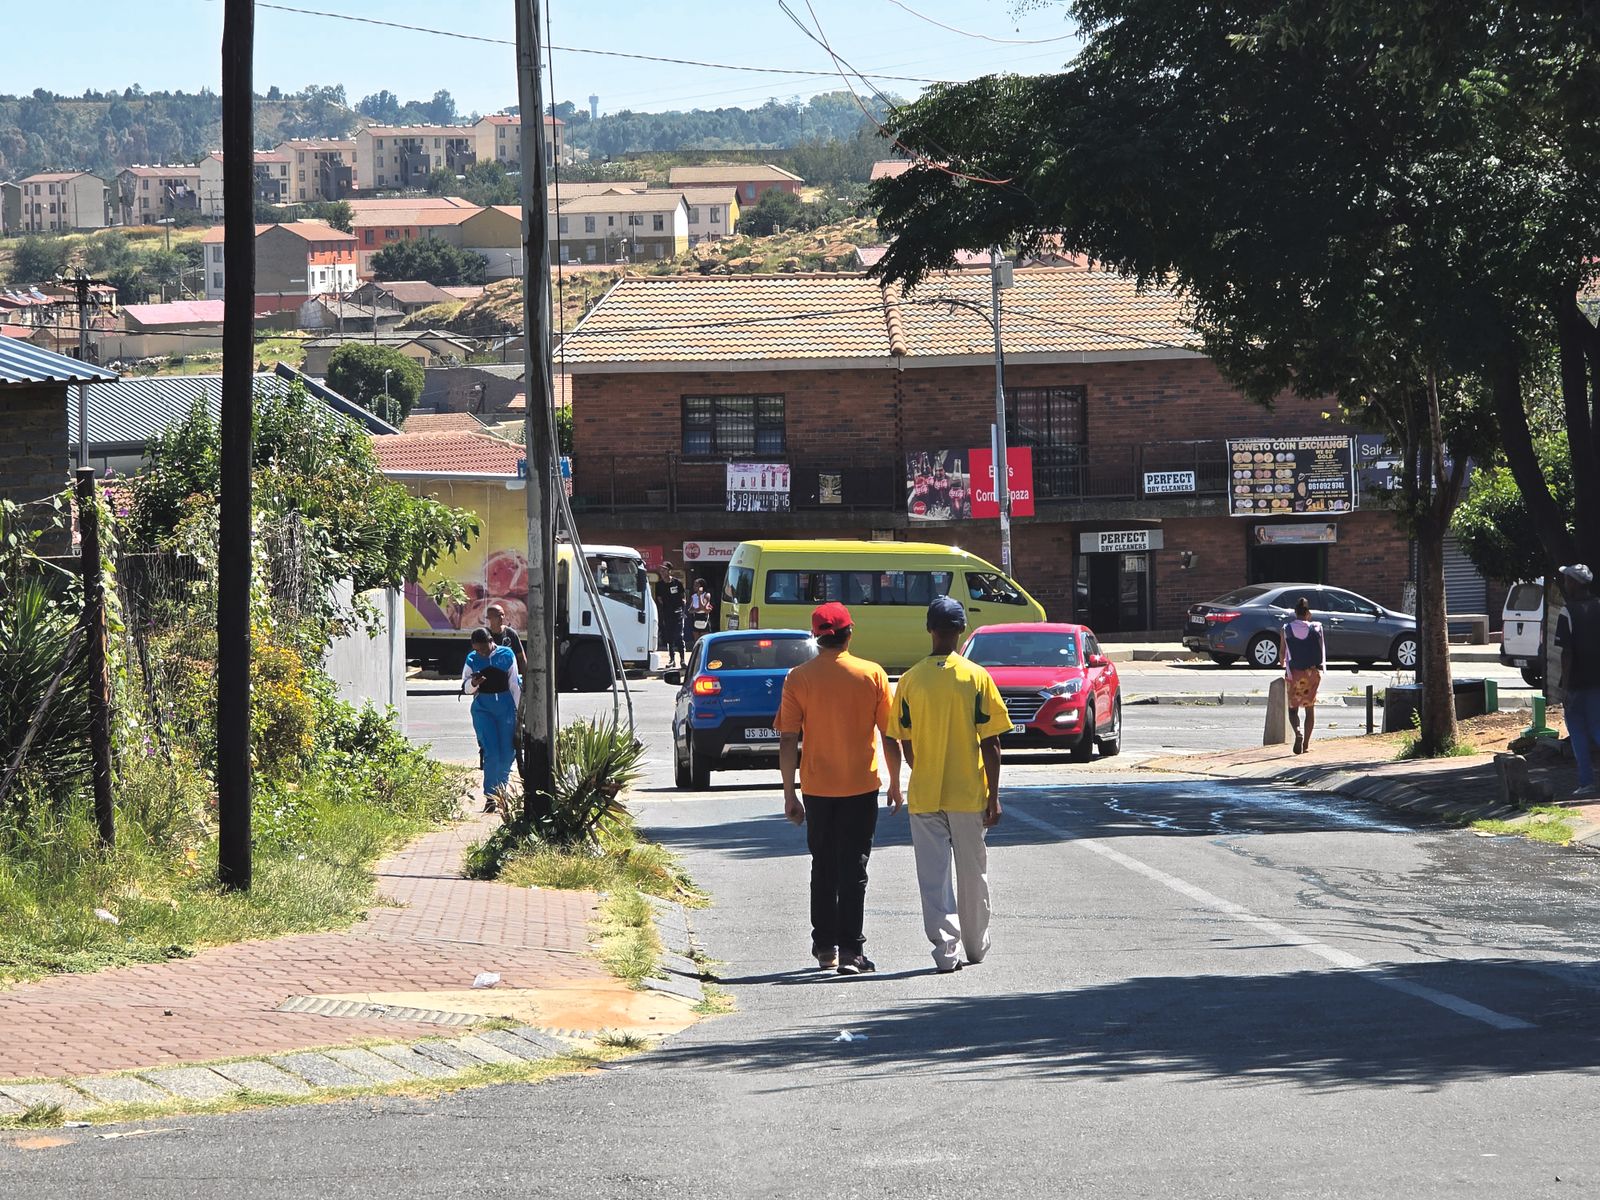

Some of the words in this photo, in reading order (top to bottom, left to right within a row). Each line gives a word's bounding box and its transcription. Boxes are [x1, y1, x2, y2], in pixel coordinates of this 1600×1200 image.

[1231, 443, 1271, 451] SOWETO
[1273, 442, 1296, 450] COIN
[1298, 441, 1349, 450] EXCHANGE
[1146, 473, 1192, 485] PERFECT
[1147, 485, 1160, 493] DRY
[1161, 484, 1193, 492] CLEANERS
[975, 489, 996, 502] Corn
[1100, 532, 1146, 544] PERFECT
[1114, 543, 1147, 551] CLEANERS
[746, 729, 755, 737] JS
[758, 728, 768, 737] 30
